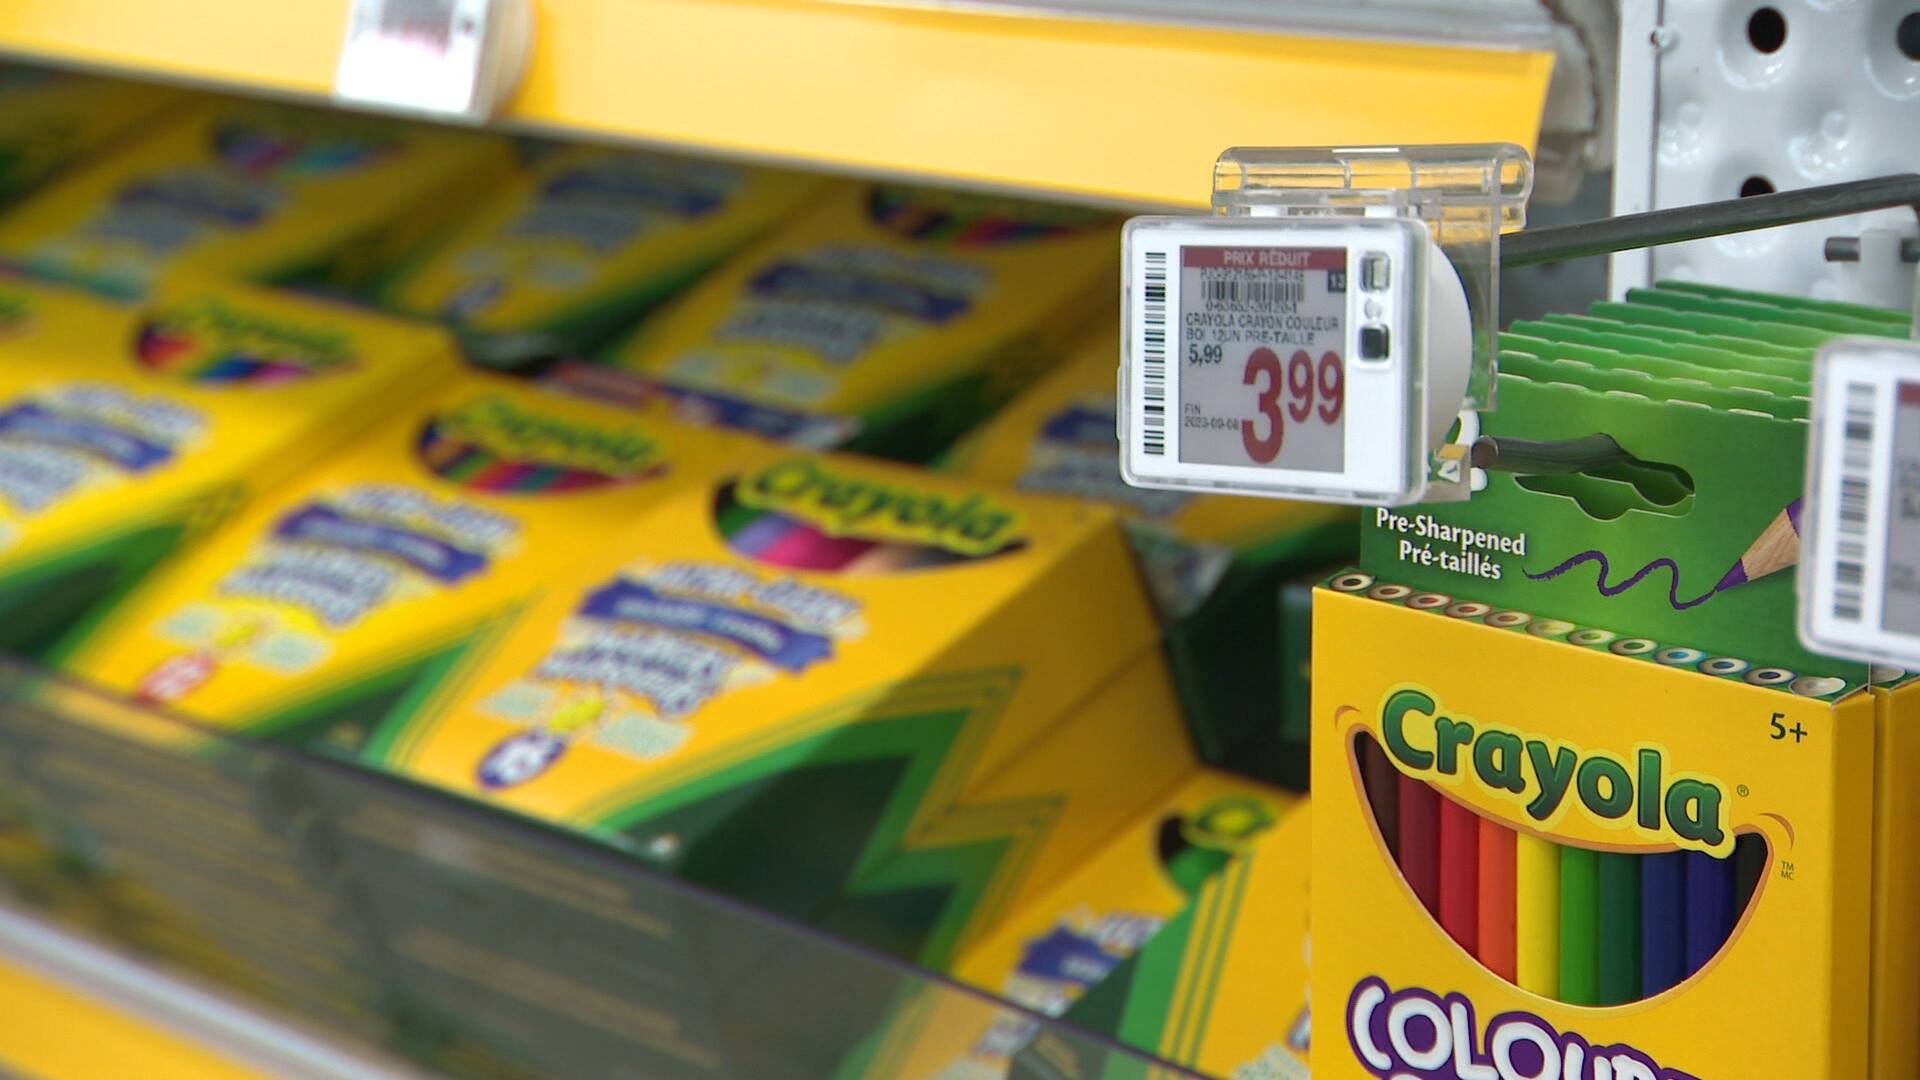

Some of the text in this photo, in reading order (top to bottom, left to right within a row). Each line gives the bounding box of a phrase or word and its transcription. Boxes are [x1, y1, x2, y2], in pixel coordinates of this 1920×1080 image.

[1223, 250, 1255, 265] PRIX
[1185, 313, 1340, 332] CRAYOLA CRAYON COULEUR
[1188, 344, 1223, 366] 5,99
[1184, 403, 1201, 415] FIN
[1375, 506, 1527, 556] Pre-Sharpened
[1399, 539, 1502, 580] Pré-taillés
[1770, 712, 1808, 744] 5+
[1382, 689, 1727, 847] Crayola
